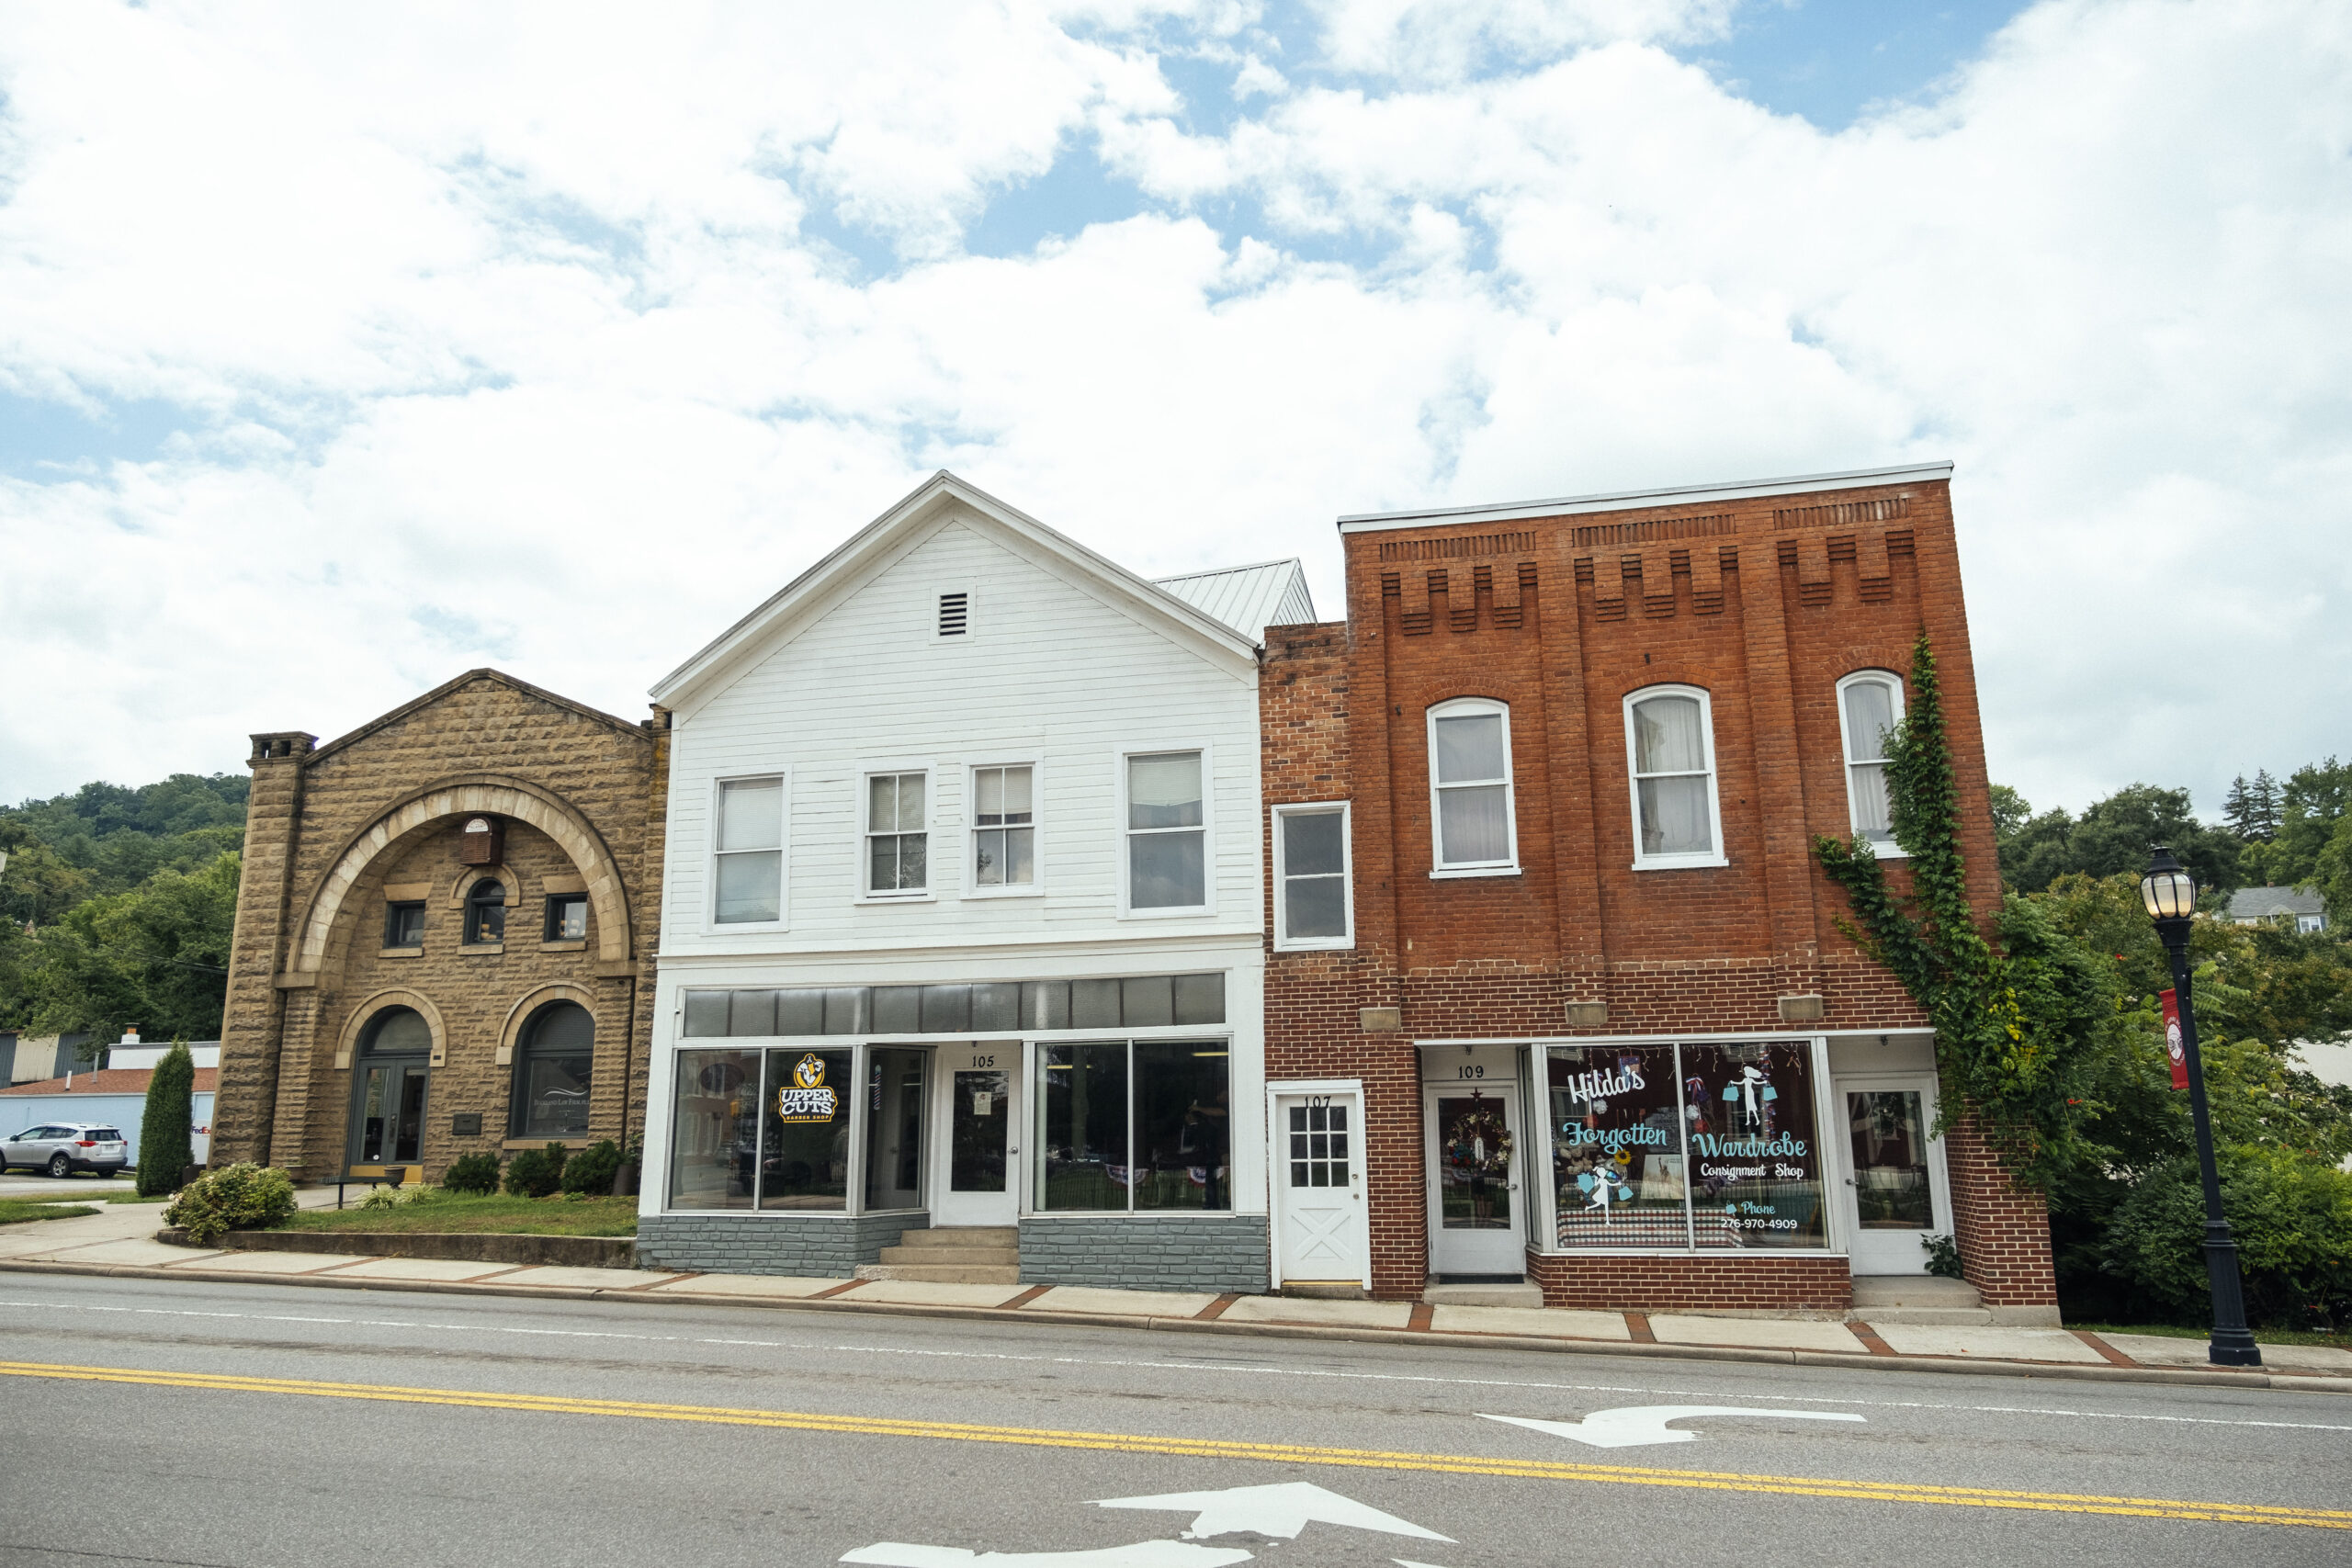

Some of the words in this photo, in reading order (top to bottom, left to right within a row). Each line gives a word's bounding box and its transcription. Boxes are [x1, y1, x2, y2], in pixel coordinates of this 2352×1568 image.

[972, 1055, 994, 1067] 105
[1458, 1066, 1484, 1078] 109
[1567, 1066, 1645, 1104] Hilda's
[781, 1089, 835, 1102] UPPER
[781, 1101, 833, 1114] CUTS
[1304, 1096, 1331, 1109] 107
[1563, 1122, 1668, 1155] Forgotten
[1691, 1131, 1807, 1157] Wardrobe
[1701, 1163, 1766, 1180] Consignment
[1775, 1163, 1804, 1179] Shop
[1741, 1201, 1775, 1215] Phone
[1720, 1218, 1798, 1229] 276-970-4909
